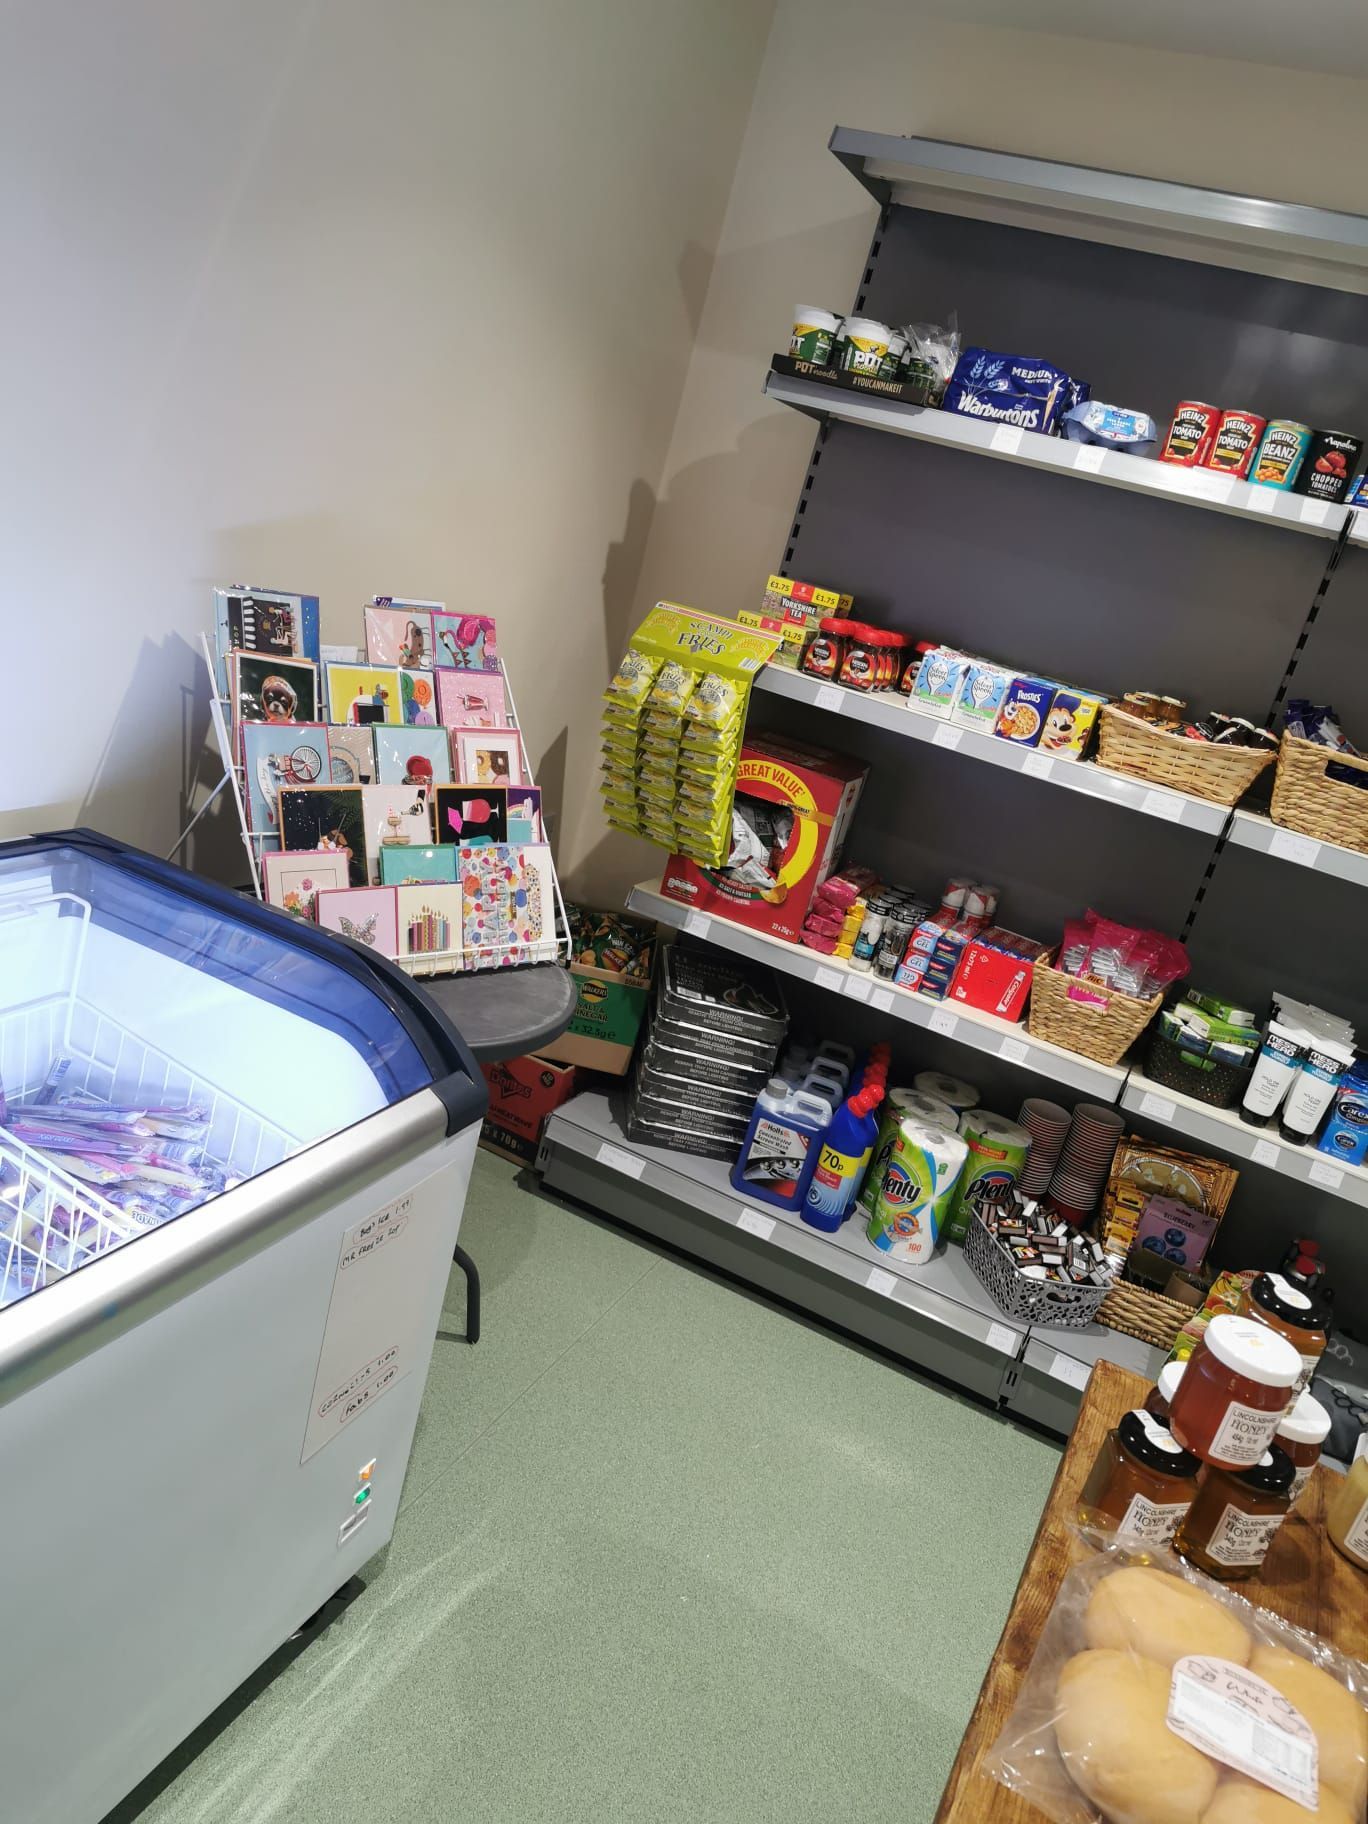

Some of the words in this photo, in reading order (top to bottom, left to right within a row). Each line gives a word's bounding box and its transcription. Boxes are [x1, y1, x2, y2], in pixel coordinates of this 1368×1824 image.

[795, 361, 814, 374] POT
[855, 351, 883, 370] POT
[1011, 367, 1052, 379] MEDIUM
[852, 376, 903, 394] #YOUCANMAKEIT
[958, 390, 1040, 428] Warburtons
[1181, 410, 1205, 423] HEINZ
[1173, 426, 1202, 439] TOMATO
[1226, 421, 1251, 432] HEINZ
[1218, 436, 1248, 449] TOMATO
[1271, 432, 1297, 444] HEINZ
[1263, 443, 1296, 459] BEANZ
[1310, 472, 1342, 488] CHOPPED
[1311, 481, 1337, 493] TOMATOES
[770, 581, 790, 591] £1.75
[815, 594, 835, 605] £1.75
[781, 597, 816, 614] YORKSHIRE
[790, 609, 802, 618] TEA
[690, 621, 732, 639] SCAMPI
[740, 616, 758, 627] £1.75
[783, 630, 802, 640] £1.75
[676, 633, 725, 655] FRIES
[661, 672, 687, 686] FRIES
[931, 666, 947, 677] Silver
[702, 681, 728, 697] FRIES
[975, 679, 992, 690] Silver
[737, 764, 771, 778] GREAT
[916, 940, 929, 948] GEL
[910, 955, 922, 965] GEL
[582, 983, 608, 997] WALKERS
[1003, 981, 1019, 1005] Colgate
[575, 1008, 608, 1022] INEGAR
[709, 1008, 744, 1021] WARNING!
[701, 1032, 735, 1046] WARNING!
[1267, 1040, 1296, 1057] HEAD
[696, 1059, 730, 1071] WARNING!
[1308, 1057, 1338, 1074] HEAD
[491, 1070, 532, 1098] Doritos
[688, 1085, 722, 1097] WARNING!
[681, 1109, 715, 1121] WARNING!
[758, 1129, 791, 1146] Concentrated
[767, 1124, 784, 1136] Holts
[757, 1135, 775, 1147] Screen
[775, 1140, 789, 1150] Wash
[824, 1150, 844, 1171] 70p
[880, 1168, 921, 1203] lenty
[908, 1243, 922, 1252] 100
[377, 1349, 396, 1366] 1.00
[376, 1370, 394, 1389] 1.00
[1232, 1410, 1278, 1424] LINCOLNSHIRE
[1230, 1419, 1268, 1436] HONEY
[1135, 1499, 1176, 1516] LINCOLNSHIRE
[1133, 1508, 1167, 1527] HONEY
[1227, 1510, 1271, 1527] LINCOLNSHIRE
[1225, 1518, 1260, 1538] HONEY
